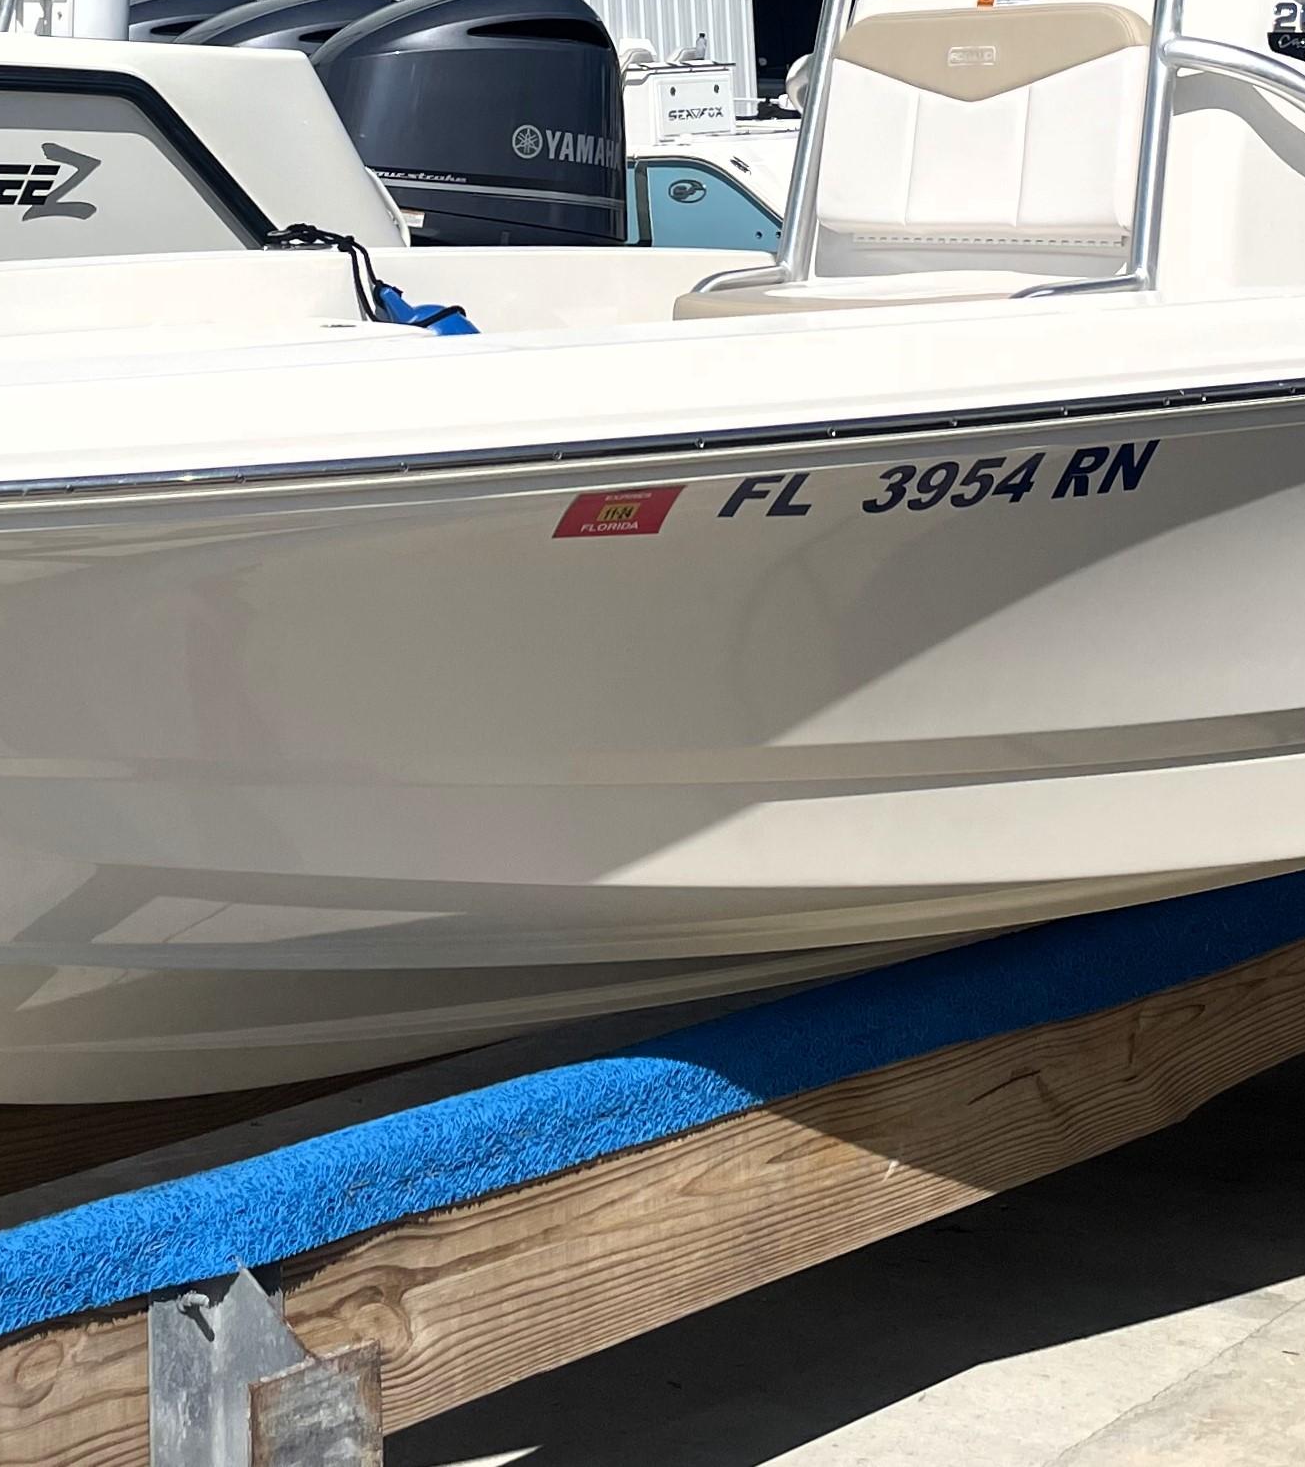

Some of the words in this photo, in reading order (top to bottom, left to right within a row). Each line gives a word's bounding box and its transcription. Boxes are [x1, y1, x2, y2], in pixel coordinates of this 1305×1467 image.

[717, 472, 813, 518] FL
[862, 452, 1046, 514] 3954
[1050, 439, 1161, 499] RN
[580, 521, 639, 533] FLORIDA
